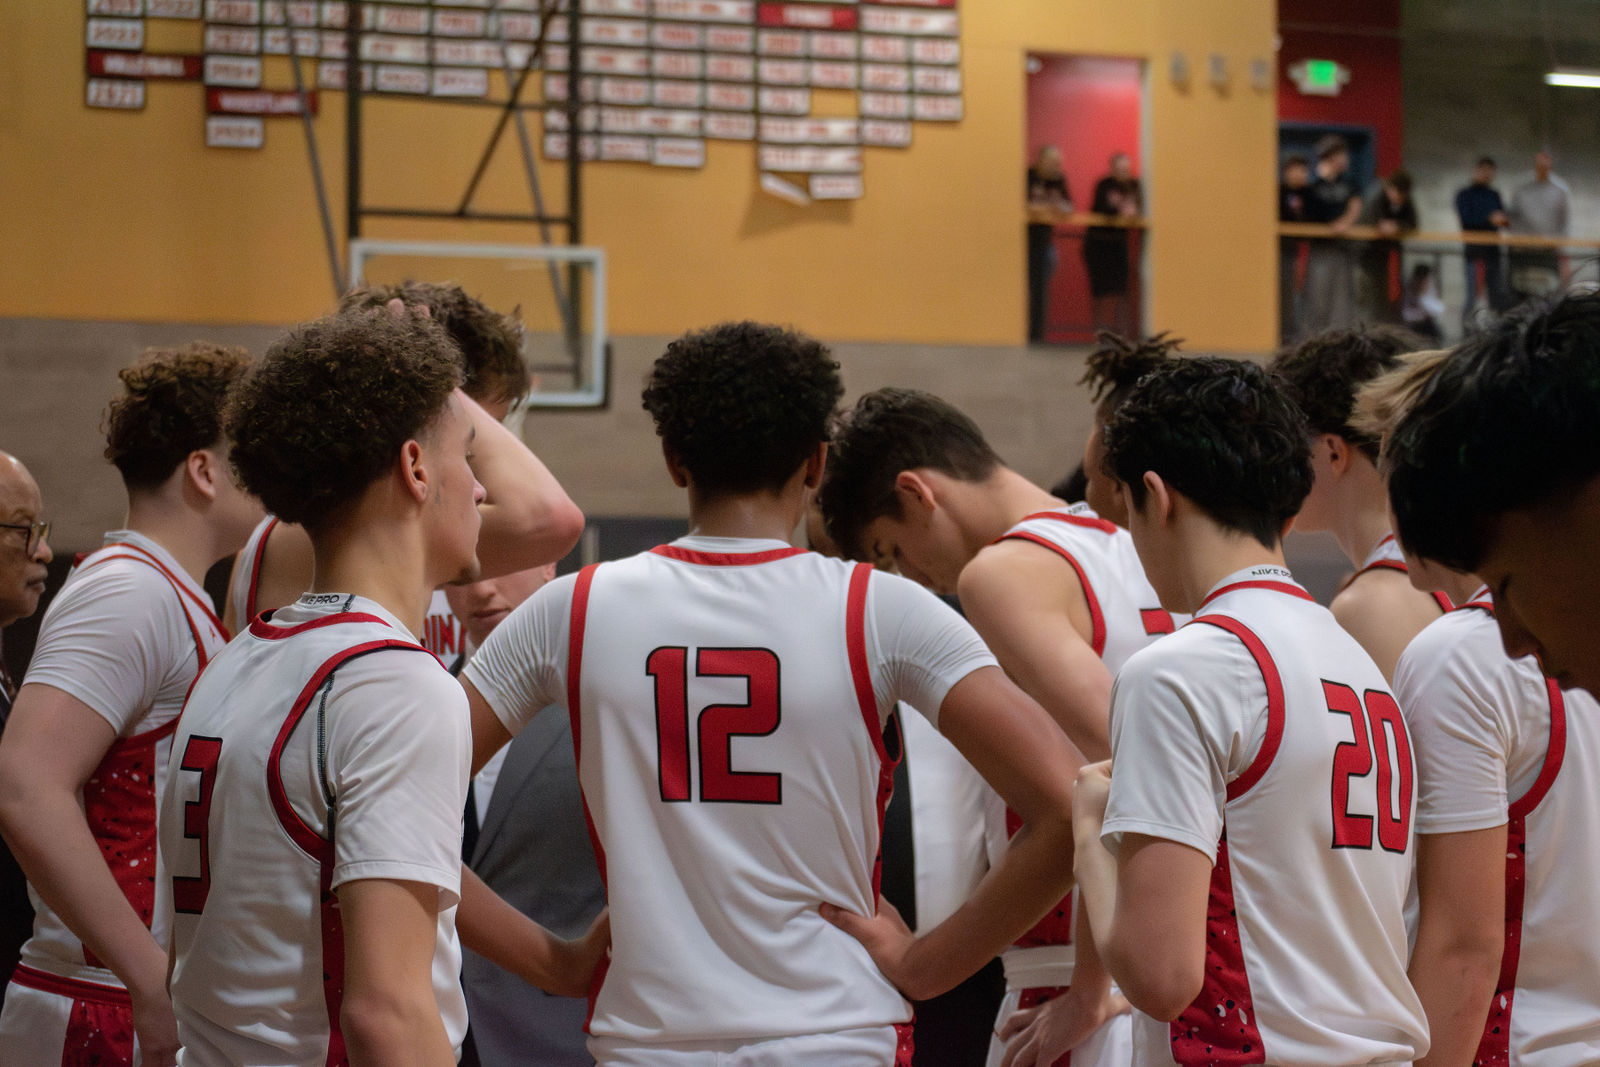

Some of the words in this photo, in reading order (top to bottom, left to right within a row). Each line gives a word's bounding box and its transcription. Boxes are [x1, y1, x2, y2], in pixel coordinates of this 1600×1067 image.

[314, 594, 340, 605] PRO
[645, 645, 782, 805] 12
[1320, 678, 1414, 855] 20
[172, 734, 224, 915] 3
